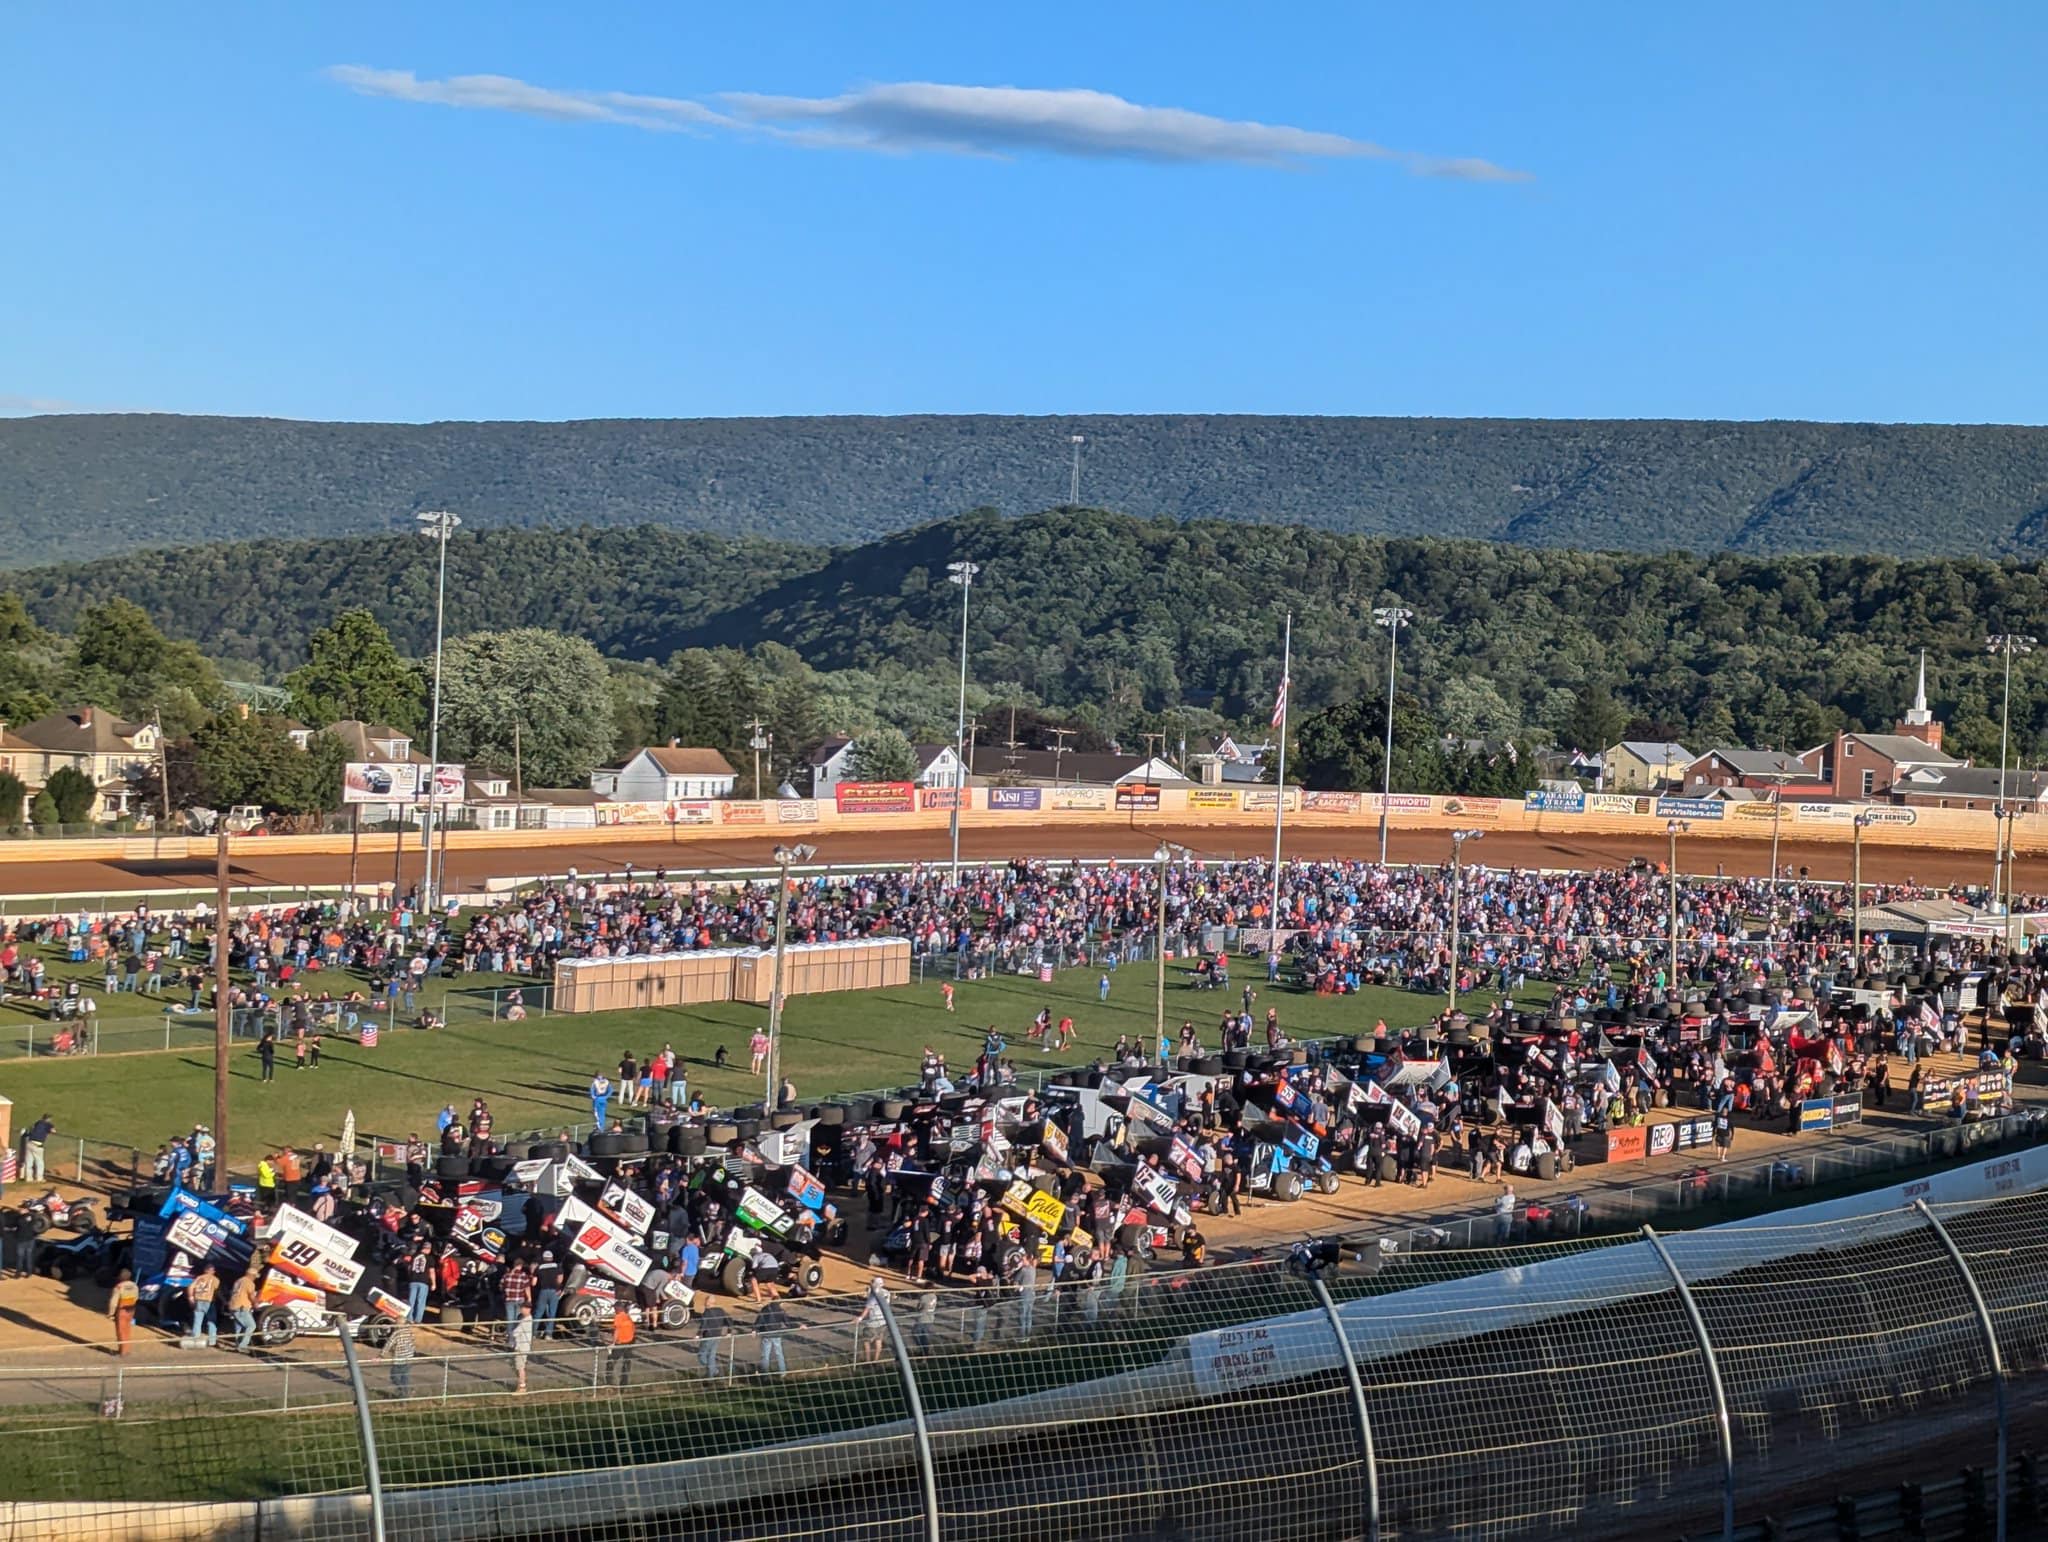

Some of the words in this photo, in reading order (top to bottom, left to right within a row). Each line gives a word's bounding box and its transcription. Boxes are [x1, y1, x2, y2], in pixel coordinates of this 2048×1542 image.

[1540, 791, 1582, 800] PARADISE
[1657, 808, 1723, 817] JRVVisitors.com
[1800, 805, 1831, 813] CASE
[176, 1214, 208, 1237] 26
[280, 1239, 321, 1267] 99
[612, 1242, 645, 1266] EZGO
[322, 1258, 357, 1280] ADAMS
